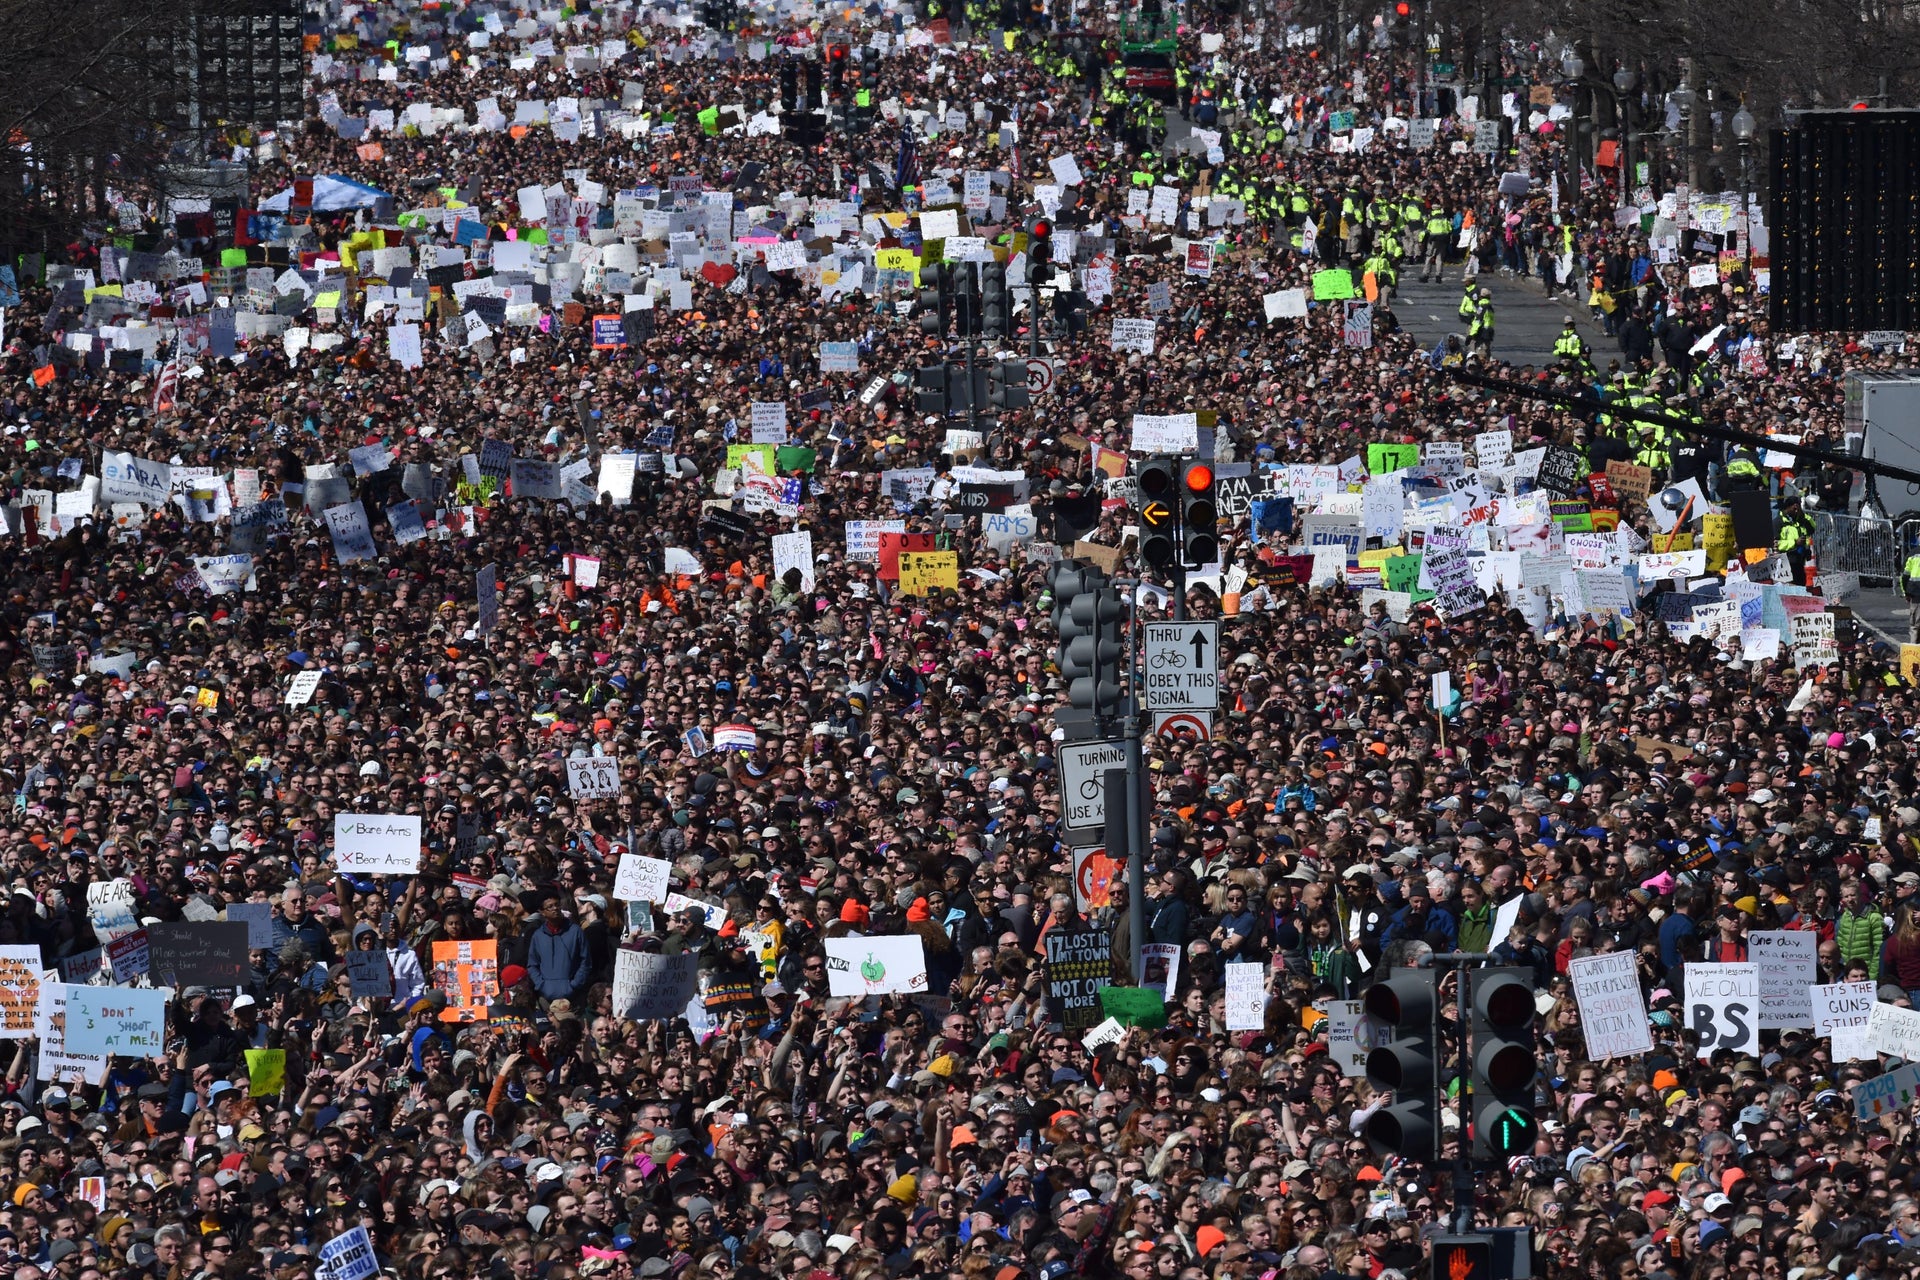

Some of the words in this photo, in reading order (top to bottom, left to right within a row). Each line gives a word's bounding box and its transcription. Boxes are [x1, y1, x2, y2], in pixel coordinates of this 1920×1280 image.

[888, 256, 902, 265] NO
[1348, 331, 1368, 345] OUT
[1382, 452, 1399, 474] 17
[1610, 464, 1641, 478] FEAR
[1219, 477, 1251, 498] AM
[1260, 475, 1274, 493] I
[1449, 472, 1479, 492] LOVE
[1366, 486, 1397, 496] SAVE
[27, 495, 47, 505] NOT
[961, 492, 985, 507] KIDS
[987, 515, 1028, 536] ARMS
[1433, 525, 1462, 538] WHEN
[1570, 538, 1604, 549] CHOOSE
[1426, 555, 1450, 568] WHEN
[1450, 548, 1465, 561] THE
[1455, 585, 1480, 598] WORLD
[1696, 607, 1721, 617] Why
[1794, 616, 1811, 628] The
[1814, 614, 1833, 629] only
[1149, 628, 1183, 642] THRU
[1795, 628, 1820, 641] thing
[1149, 673, 1182, 688] OBEY
[1186, 673, 1215, 688] THIS
[1149, 691, 1195, 705] SIGNAL
[1078, 749, 1125, 766] TURNING
[569, 761, 588, 770] Our
[573, 788, 592, 799] Your
[1069, 805, 1092, 820] USE
[356, 822, 382, 835] Bare
[385, 824, 412, 837] Arms
[355, 852, 378, 866] Bear
[384, 853, 411, 866] Arms
[632, 859, 659, 873] MASS
[622, 870, 665, 886] CASUALTY
[89, 884, 110, 905] WE
[619, 886, 658, 901] SUCKS
[1750, 934, 1772, 946] One
[1046, 936, 1064, 963] 17
[1064, 933, 1096, 949] LOST
[1098, 932, 1110, 947] IN
[1141, 945, 1151, 956] WE
[1151, 944, 1177, 955] MARCH
[3, 957, 38, 965] POWER
[620, 952, 656, 970] TRADE
[1060, 949, 1073, 963] MY
[1074, 947, 1110, 961] TOWN
[827, 957, 849, 971] NRA
[1573, 964, 1584, 979] I
[1584, 960, 1605, 977] WANT
[1606, 959, 1618, 974] TO
[1617, 955, 1633, 971] BE
[13, 968, 29, 976] THE
[620, 968, 666, 985] THOUGHTS
[28, 978, 36, 986] IS
[908, 972, 926, 988] GOP
[1051, 979, 1080, 997] NOT
[1085, 976, 1112, 995] ONE
[619, 982, 658, 996] PRAYERS
[704, 984, 752, 997] DISARM
[1246, 984, 1264, 992] THAN
[1578, 980, 1603, 999] SENT
[1602, 977, 1621, 995] HOME
[1688, 980, 1714, 998] WE
[1718, 979, 1758, 997] CALL
[1823, 985, 1847, 997] IT'S
[1851, 983, 1873, 993] THE
[72, 991, 80, 1001] 1
[1064, 994, 1096, 1009] MORE
[81, 1005, 90, 1016] 2
[1227, 1001, 1249, 1010] GUNS
[1760, 999, 1785, 1009] YOUR
[1786, 999, 1813, 1007] GUNS
[1239, 1014, 1264, 1024] EARTH
[1872, 1004, 1918, 1027] BLESSED
[1, 1021, 35, 1029] POWER
[86, 1019, 95, 1029] 3
[117, 1020, 153, 1032] SHOOT
[1592, 1018, 1609, 1036] NOT
[1611, 1015, 1625, 1033] IN
[1627, 1013, 1637, 1032] A
[1693, 1002, 1751, 1049] BS
[105, 1035, 121, 1046] AT
[45, 1050, 64, 1058] THAN
[65, 1053, 100, 1062] HOLDING
[1857, 1074, 1898, 1104] 2020
